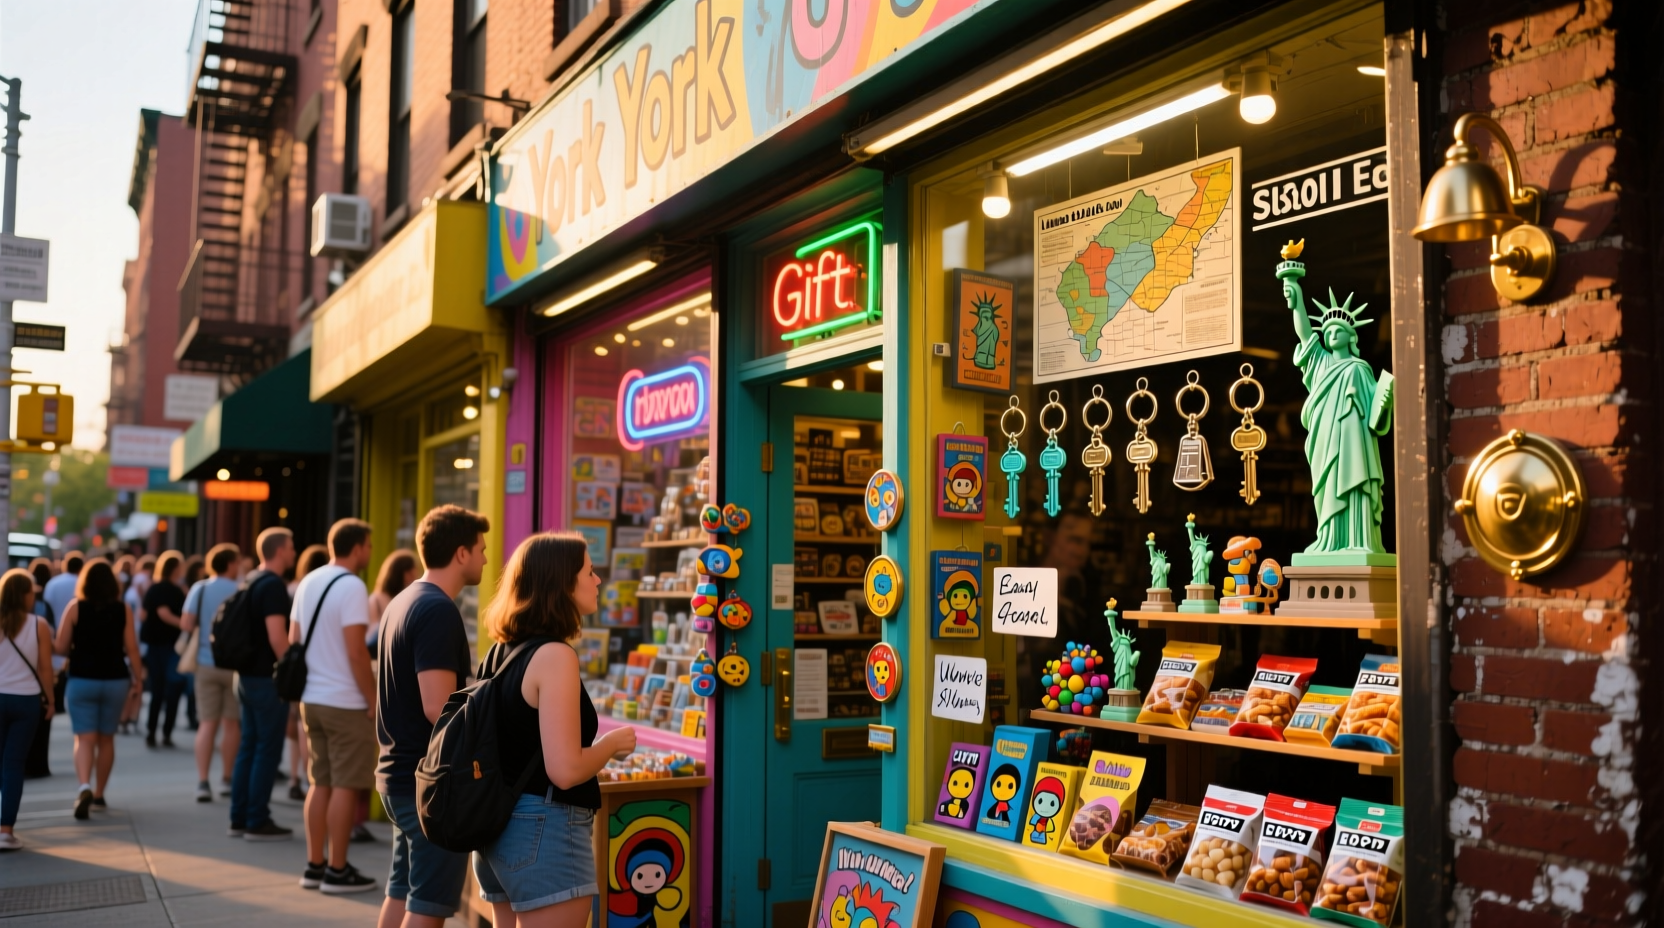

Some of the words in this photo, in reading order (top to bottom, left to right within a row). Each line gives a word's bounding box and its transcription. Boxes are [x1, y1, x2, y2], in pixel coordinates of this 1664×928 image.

[527, 99, 606, 245] York
[613, 0, 737, 190] York
[773, 250, 852, 327] Gift
